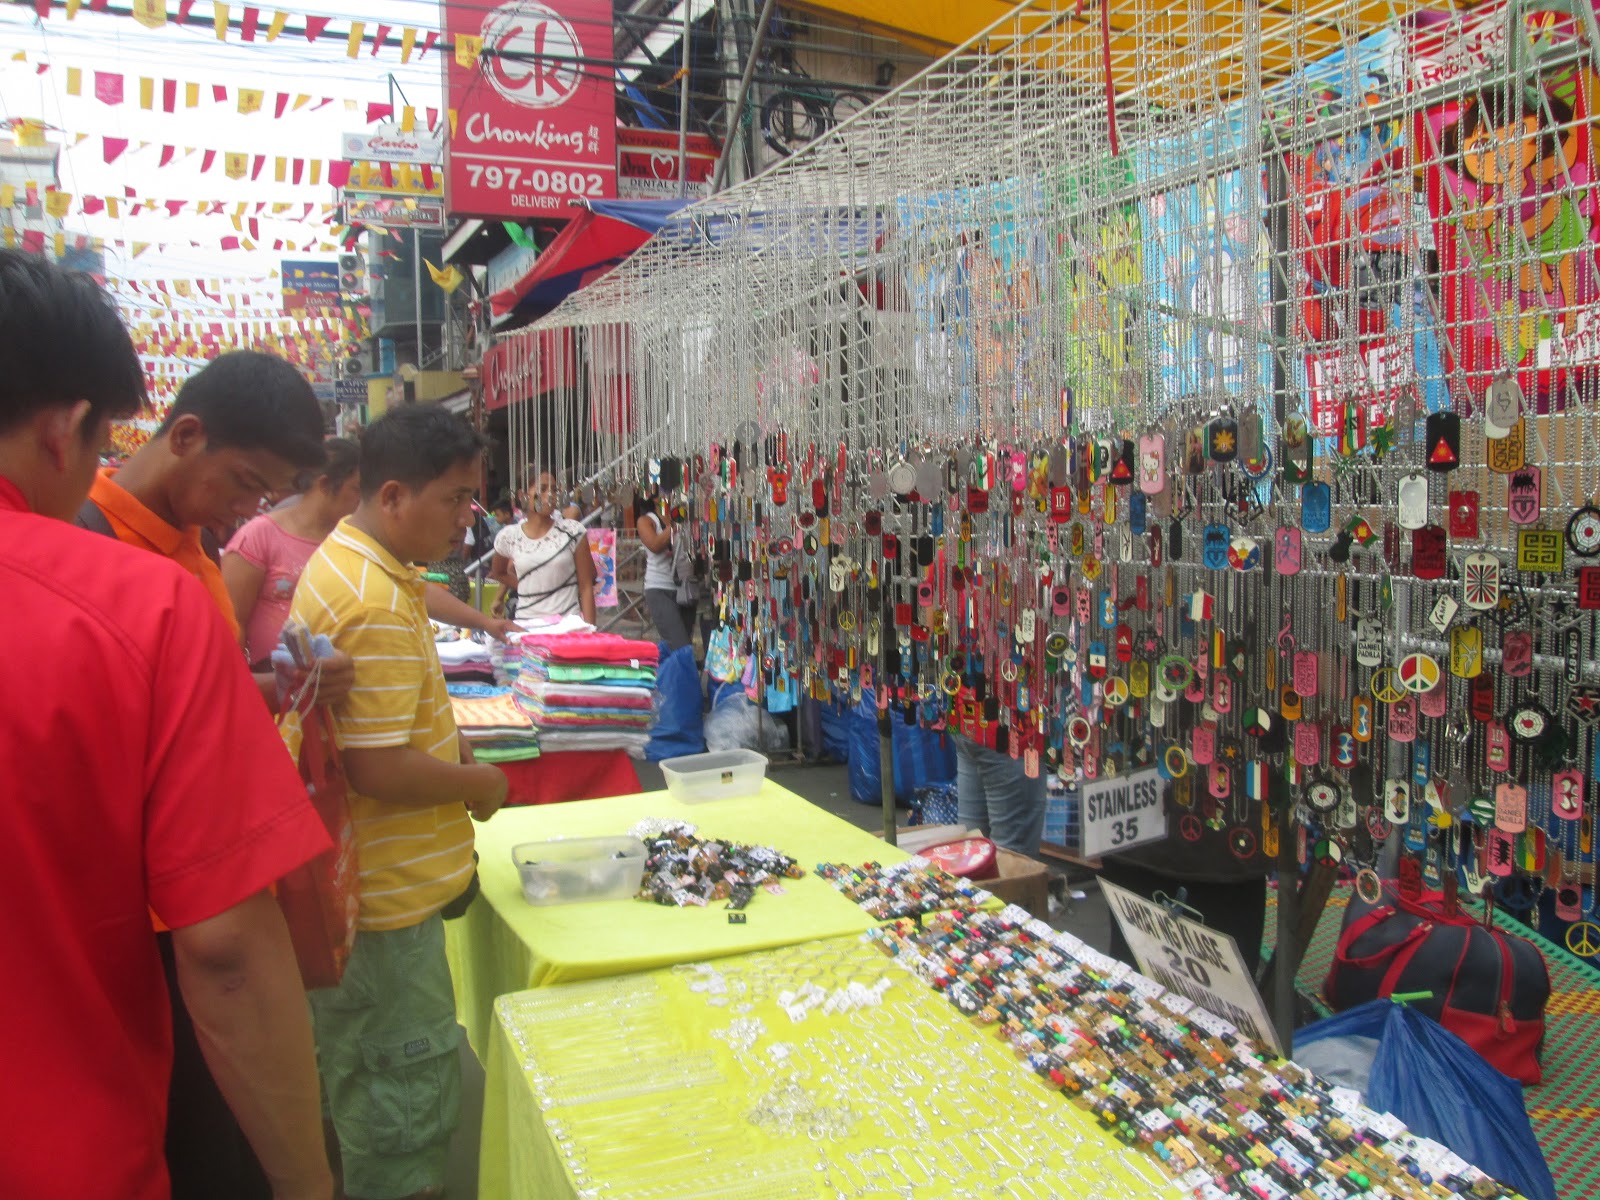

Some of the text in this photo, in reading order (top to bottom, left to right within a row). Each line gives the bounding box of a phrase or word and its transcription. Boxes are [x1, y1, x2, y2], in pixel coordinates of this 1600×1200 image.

[465, 112, 584, 154] Chowking
[466, 163, 604, 196] 797-0802
[630, 178, 669, 189] DENTAL
[511, 194, 561, 209] DELIVERY
[306, 296, 333, 305] LOANS
[1359, 643, 1380, 651] DANIEL
[1088, 779, 1157, 822] STAINLESS
[1496, 815, 1524, 826] PADILLA
[1497, 808, 1522, 818] DANIEL
[1111, 816, 1139, 845] 35
[1114, 892, 1231, 974] LAHAT NG KLASE
[1162, 945, 1211, 988] 20
